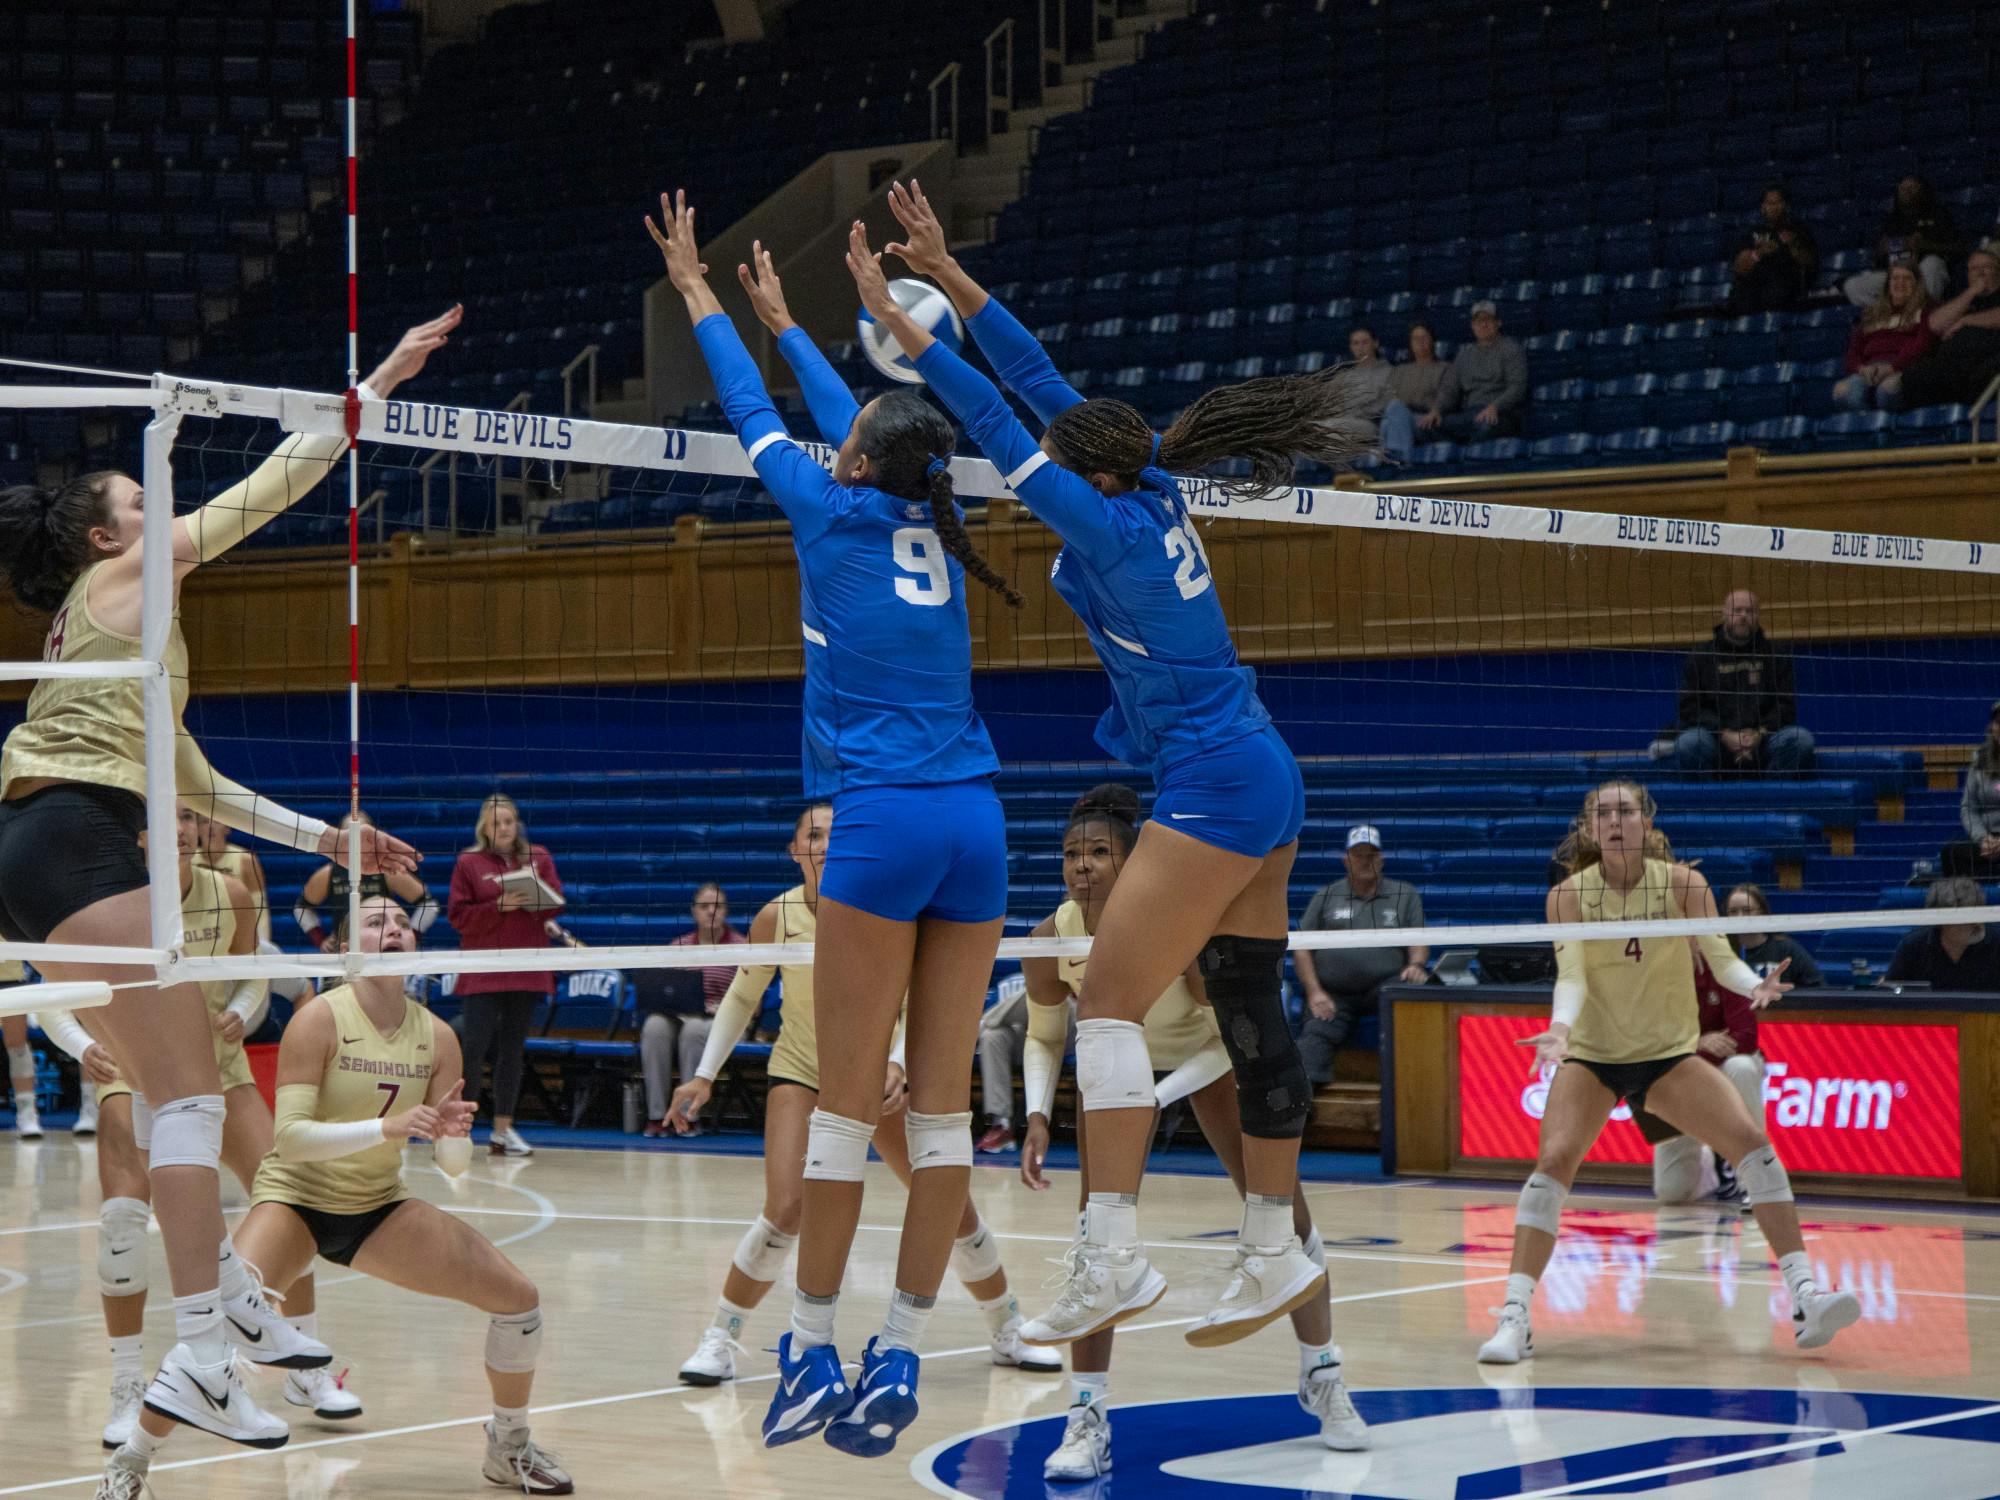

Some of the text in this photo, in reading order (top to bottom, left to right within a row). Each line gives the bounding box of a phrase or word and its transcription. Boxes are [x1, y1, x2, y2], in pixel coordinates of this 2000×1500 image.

[184, 384, 211, 396] Senoh
[384, 401, 572, 450] BLUE DEVILS
[1375, 495, 1492, 529] BLUE DEVILS
[1617, 516, 1721, 547] BLUE DEVILS
[1832, 533, 1924, 561] BLUE DEVILS
[892, 527, 952, 606] 9
[1624, 937, 1643, 963] 4
[568, 973, 616, 998] DUKE
[339, 1055, 432, 1080] SEMINOLES
[377, 1082, 400, 1119] 7
